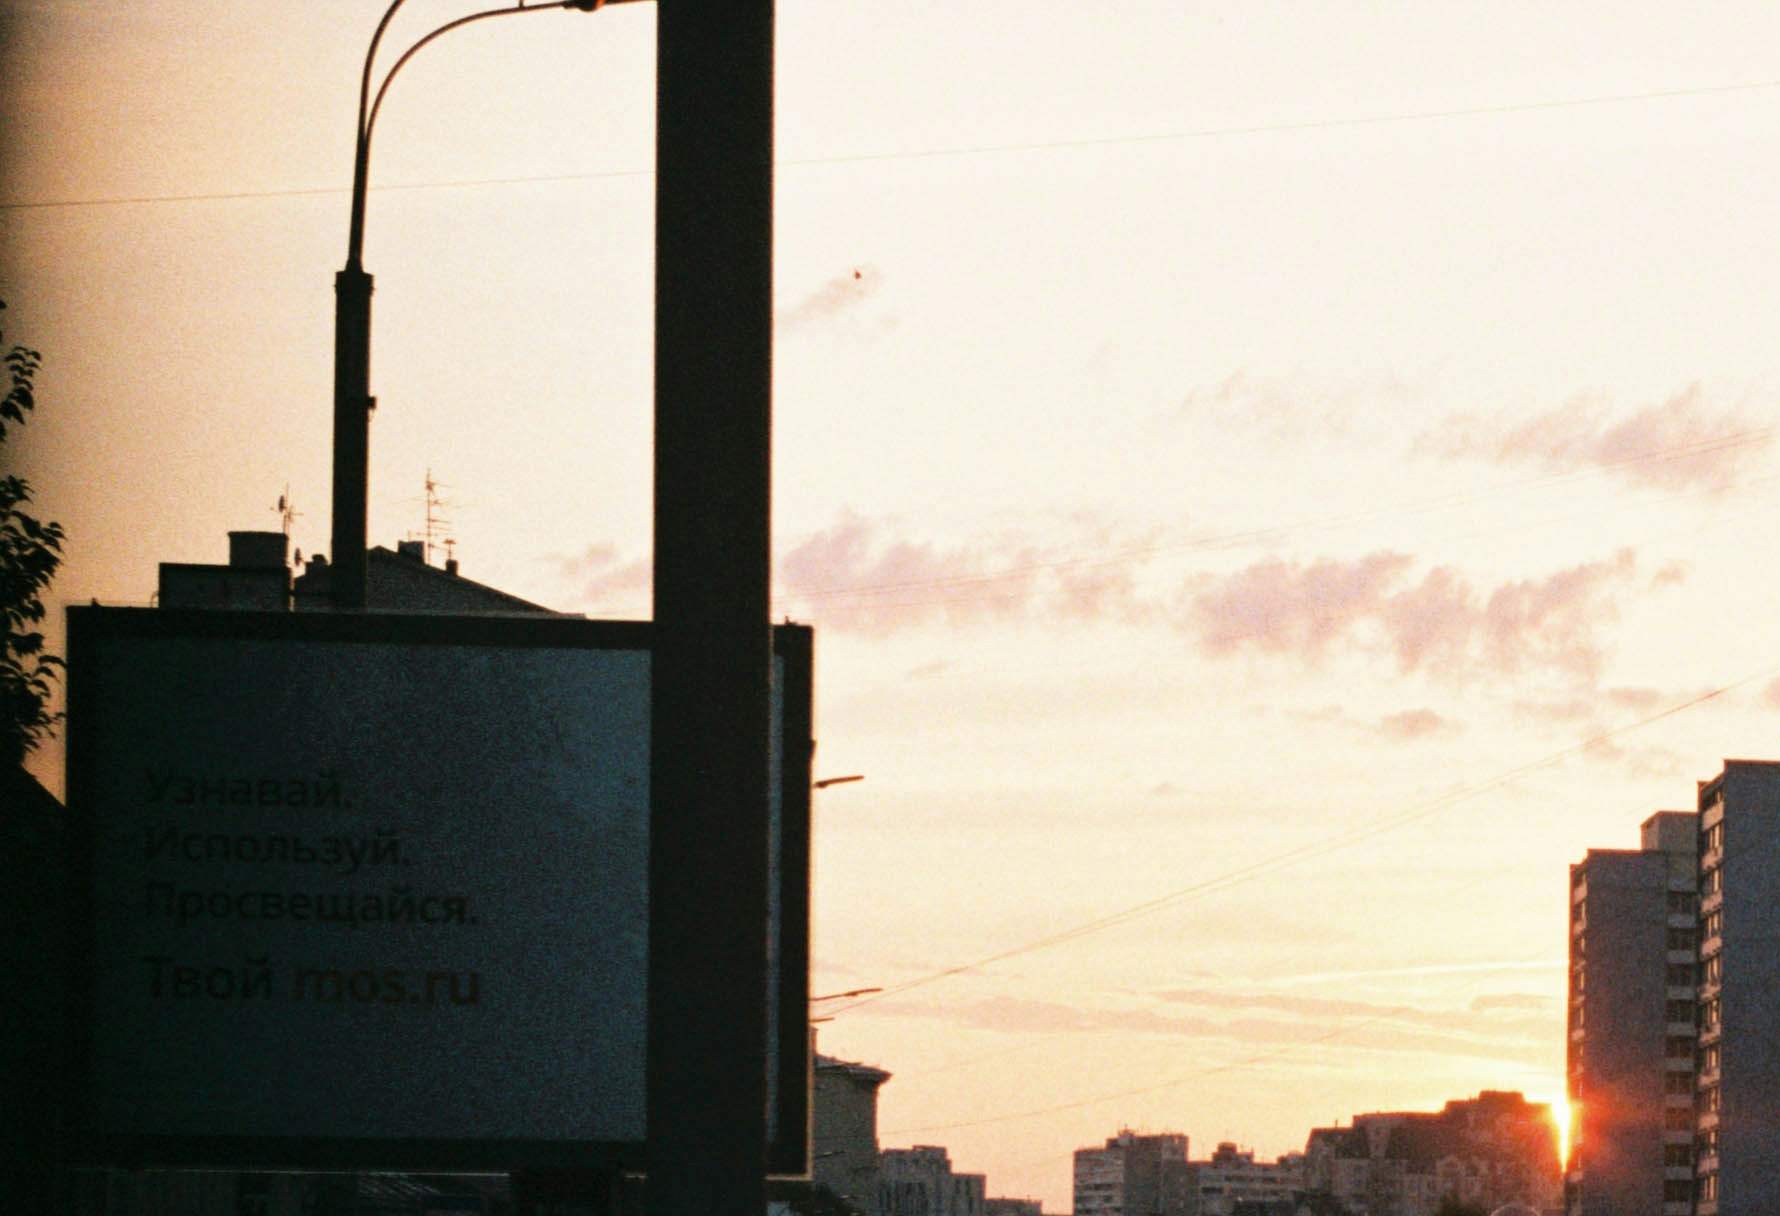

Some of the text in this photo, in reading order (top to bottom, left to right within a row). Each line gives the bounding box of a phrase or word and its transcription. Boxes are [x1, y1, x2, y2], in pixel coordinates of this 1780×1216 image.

[143, 768, 353, 809] Узнавай.
[143, 826, 411, 874] Используй.
[143, 881, 479, 929] Просвещайся.
[143, 953, 481, 1006] Твой mos.ru
